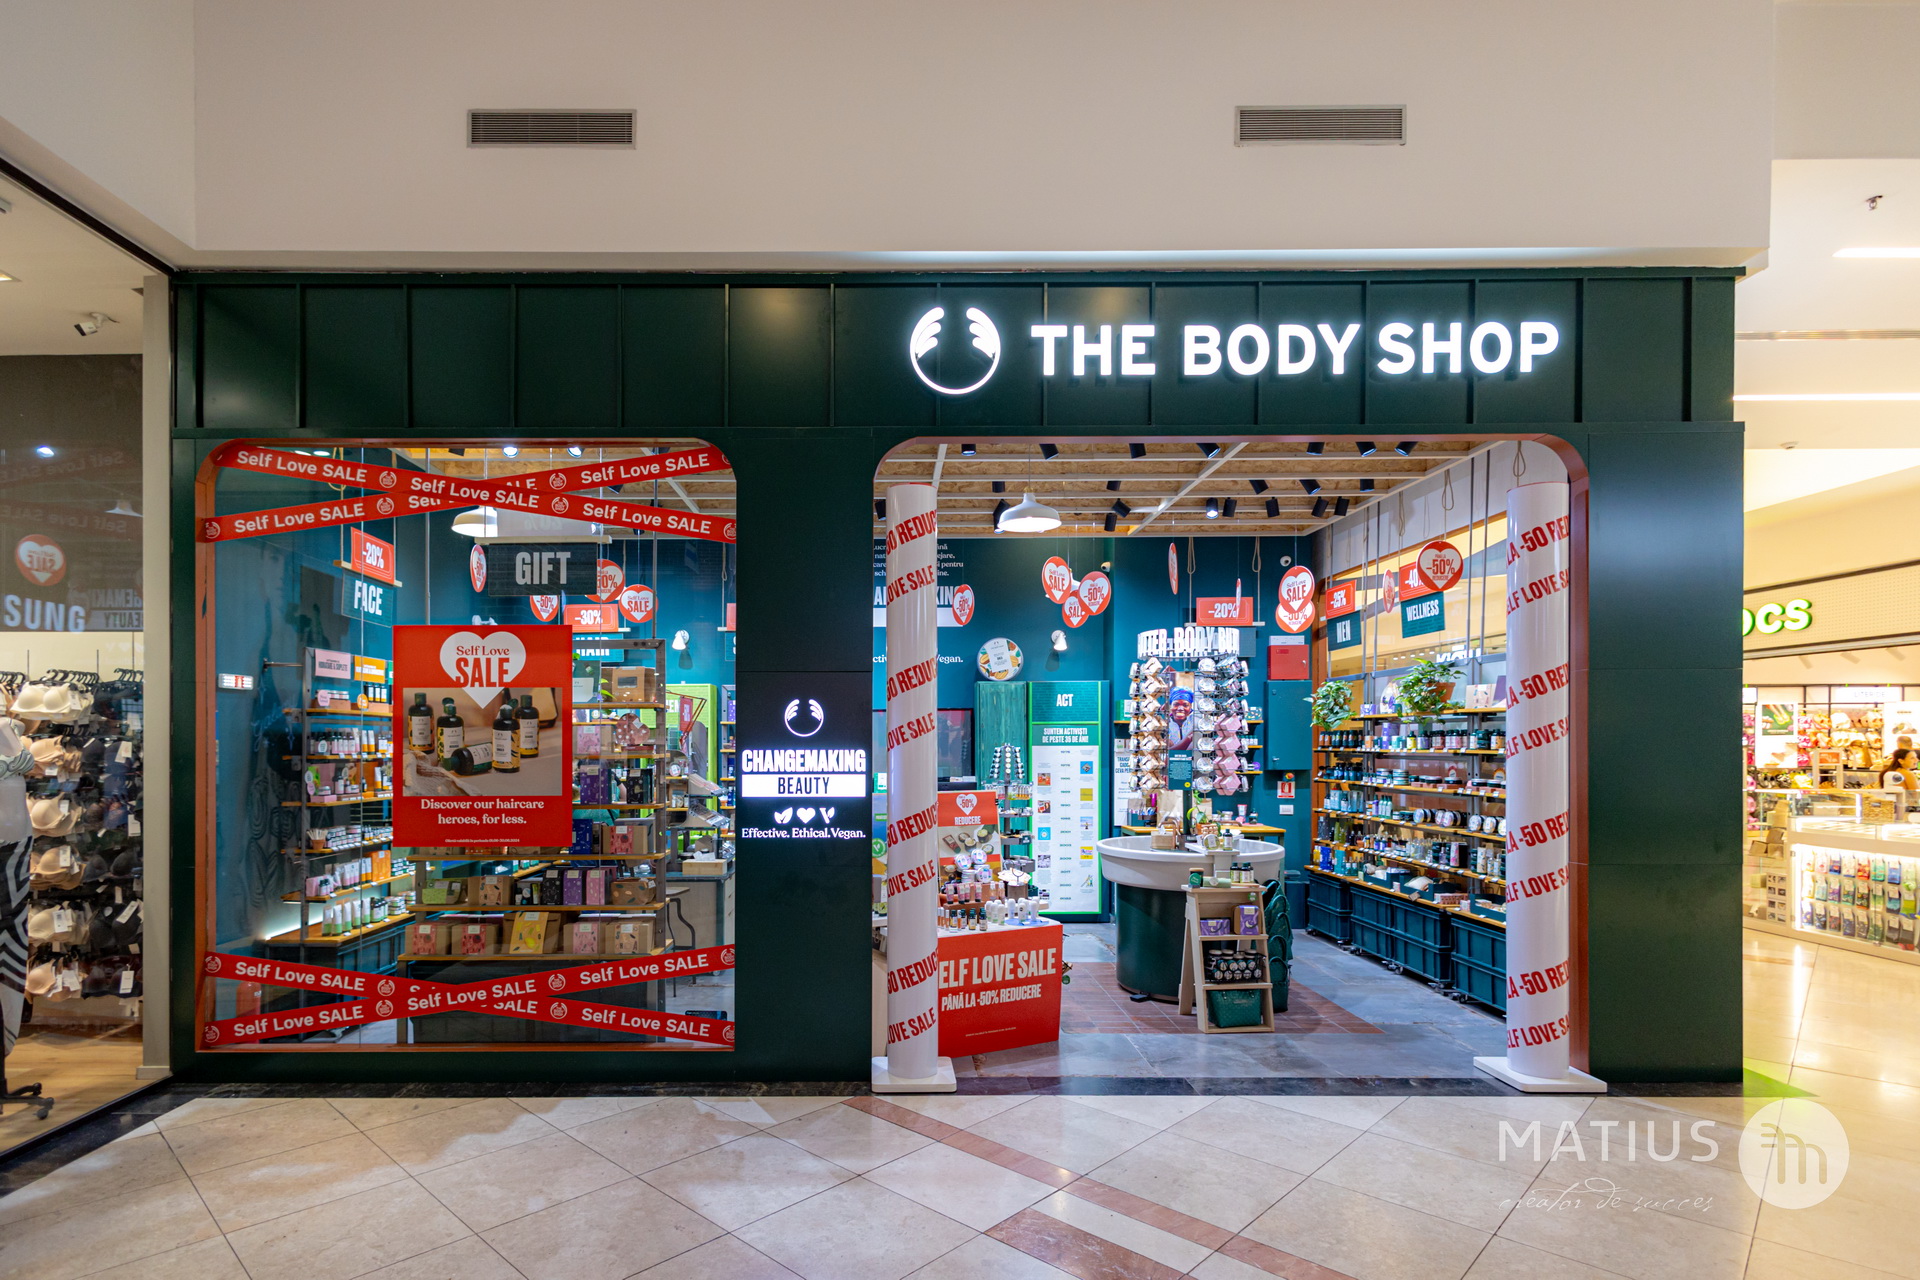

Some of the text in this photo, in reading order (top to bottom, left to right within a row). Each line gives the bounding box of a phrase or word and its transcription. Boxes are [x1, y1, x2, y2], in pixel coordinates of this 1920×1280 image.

[1030, 321, 1560, 376] THE BODY SHOP
[237, 451, 272, 468] Self
[277, 457, 317, 475] Love
[322, 464, 368, 483] SALE
[580, 466, 615, 484] Self
[620, 463, 660, 479] Love
[665, 453, 710, 471] SALE
[410, 477, 446, 495] Self
[450, 483, 489, 501] Love
[494, 490, 540, 509] SALE
[234, 515, 269, 533] Self
[274, 513, 315, 528] Love
[320, 503, 365, 521] SALE
[583, 503, 618, 520] Self
[622, 511, 662, 526] Love
[667, 515, 712, 535] SALE
[895, 509, 937, 545] REDUC
[1520, 526, 1549, 552] -50
[362, 543, 384, 568] -20%
[515, 551, 571, 586] GIFT
[1426, 558, 1456, 575] -50%
[906, 565, 935, 591] SALE
[1049, 575, 1065, 592] SALE
[1520, 574, 1560, 603] LOVE
[354, 580, 383, 616] FACE
[627, 600, 650, 613] SALE
[1083, 587, 1105, 603] -50%
[1287, 585, 1307, 602] SALE
[575, 609, 603, 625] -30%
[1208, 603, 1238, 618] -20%
[1406, 599, 1440, 622] WELLNESS
[456, 645, 510, 656] Self Love
[455, 657, 511, 688] SALE
[896, 657, 937, 693] REDUC
[1056, 693, 1074, 707] ACT
[1519, 674, 1549, 699] -50
[907, 712, 936, 740] SALE
[1519, 723, 1560, 751] LOVE
[742, 749, 866, 772] CHANGEMAKING
[778, 777, 830, 794] BEAUTY
[421, 798, 545, 810] Discover our haircare
[438, 814, 527, 826] heroes, for less.
[741, 827, 867, 840] Effective. Ethical. Vegan.
[896, 801, 938, 842] REDUC
[1519, 822, 1548, 847] -50
[907, 859, 936, 888] SALE
[1520, 872, 1560, 898] LOVE
[235, 962, 366, 991] Self Love SALE
[579, 967, 614, 985] Self
[620, 964, 660, 980] Love
[664, 954, 709, 972] SALE
[897, 947, 938, 990] REDUC
[939, 947, 1057, 989] ELF LOVE SALE
[407, 993, 442, 1011] Self
[446, 988, 487, 1005] Love
[492, 979, 537, 998] SALE
[965, 992, 977, 1008] LA
[977, 989, 1000, 1006] -50%
[1000, 983, 1042, 1003] REDUCERE
[1519, 971, 1549, 996] -50
[234, 1005, 364, 1037] Self Love SALE
[581, 1008, 617, 1025] Self
[620, 1014, 661, 1030] Love
[665, 1020, 711, 1037] SALE
[908, 1006, 937, 1037] SALE
[1520, 1022, 1561, 1047] LOVE
